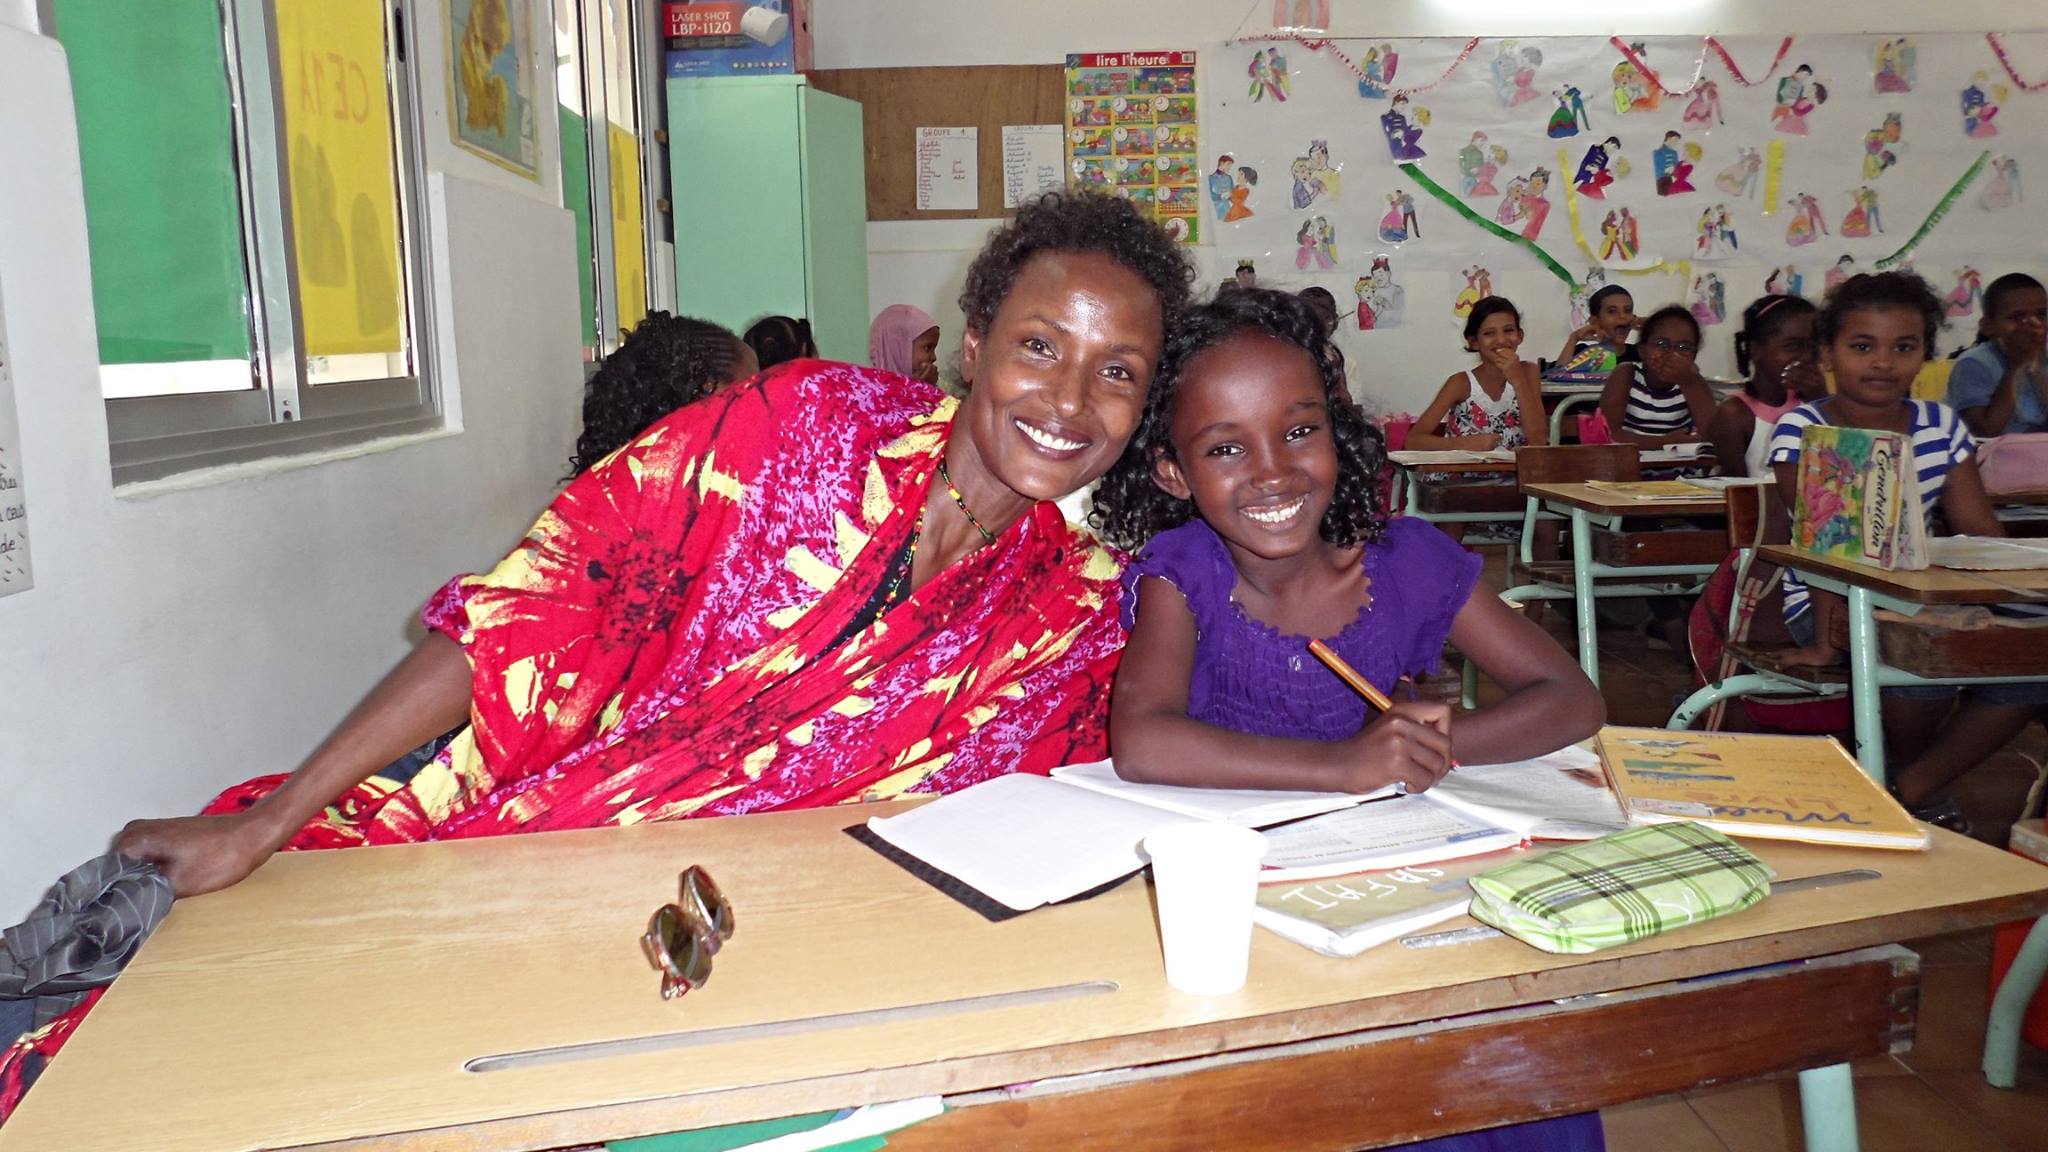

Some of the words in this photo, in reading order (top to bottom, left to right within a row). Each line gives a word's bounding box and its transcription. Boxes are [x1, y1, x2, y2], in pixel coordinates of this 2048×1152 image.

[671, 12, 701, 22] LASER
[704, 11, 731, 21] SHOT
[672, 22, 732, 36] LBP-1120
[1096, 55, 1118, 67] lire
[1122, 53, 1168, 66] l'heure
[1872, 449, 1892, 548] Cendrillon
